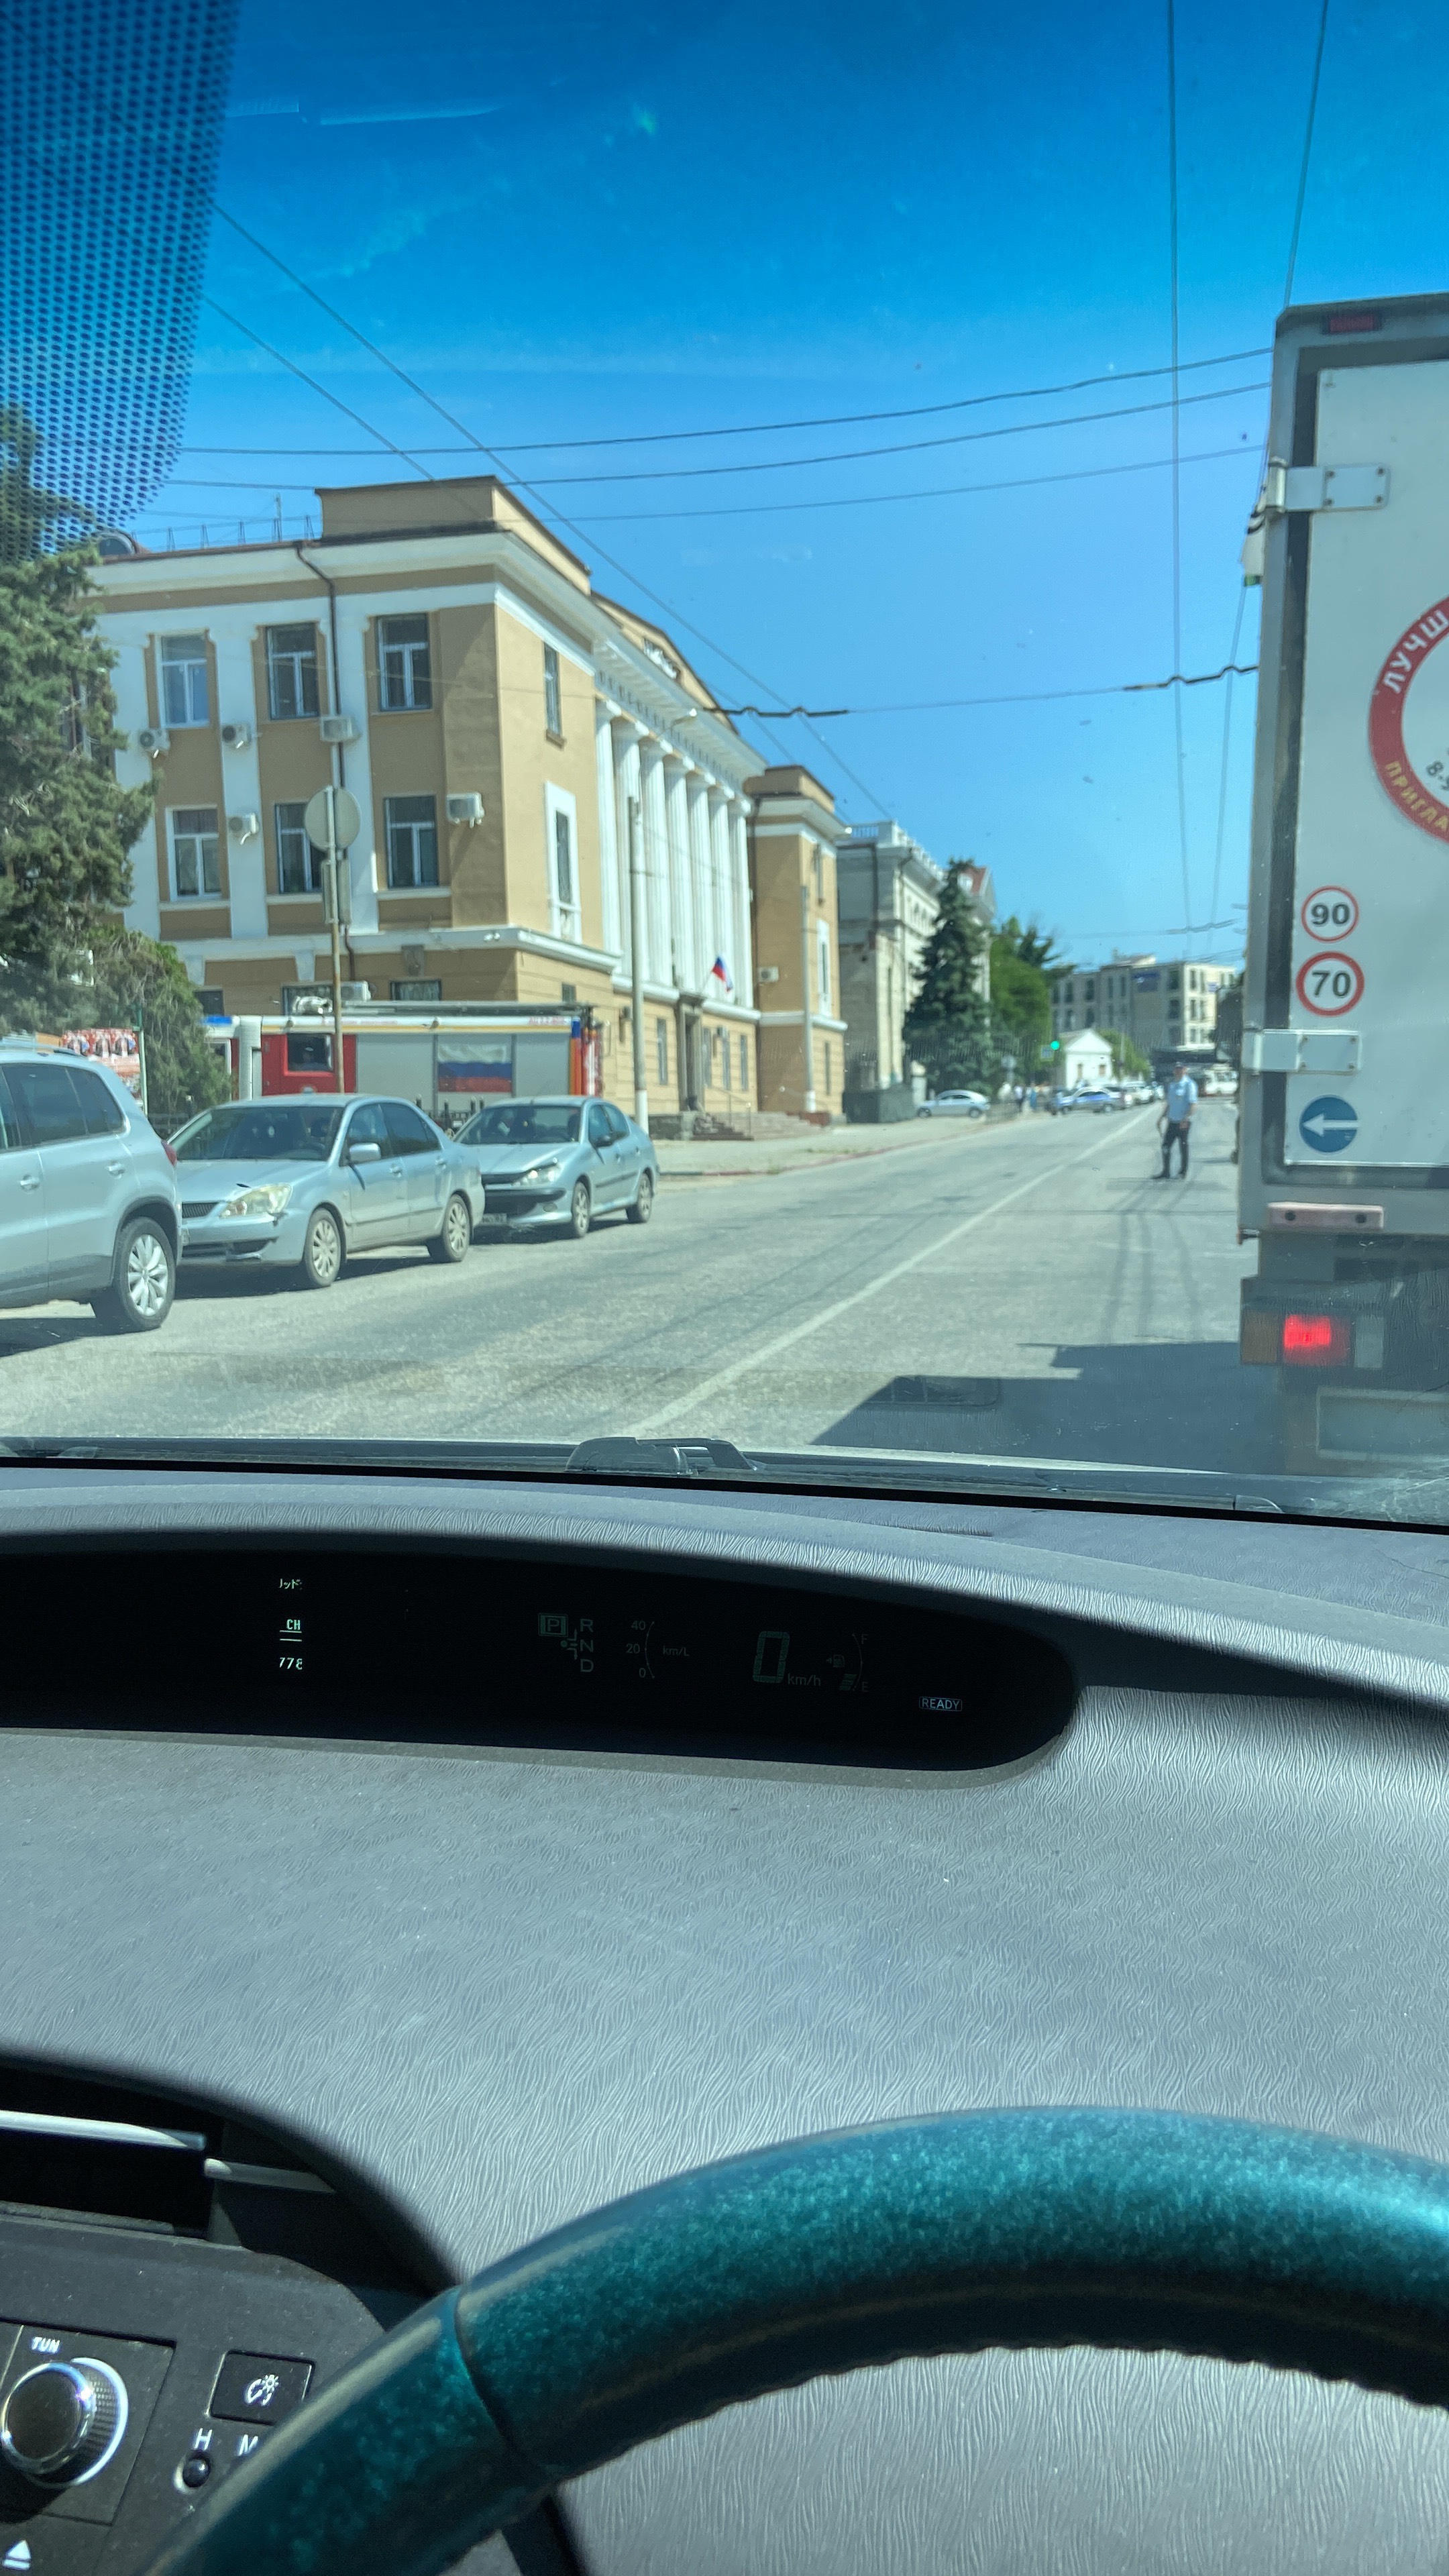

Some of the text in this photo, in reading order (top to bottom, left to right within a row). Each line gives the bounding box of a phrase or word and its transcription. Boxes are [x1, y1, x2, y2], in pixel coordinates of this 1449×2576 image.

[1311, 904, 1350, 926] 90
[1311, 970, 1352, 998] 70
[286, 1619, 301, 1630] CH
[547, 1619, 560, 1632] P
[580, 1619, 594, 1632] R
[631, 1620, 646, 1630] 40
[861, 1634, 868, 1644] F
[580, 1640, 594, 1652] N
[626, 1643, 640, 1654] 20
[663, 1646, 690, 1657] km/L
[753, 1631, 821, 1686] 0 km/h
[580, 1658, 594, 1672] D
[639, 1668, 647, 1678] 0
[862, 1682, 869, 1693] E
[922, 1698, 960, 1710] READY
[32, 2337, 60, 2353] TUN
[194, 2428, 213, 2451] H
